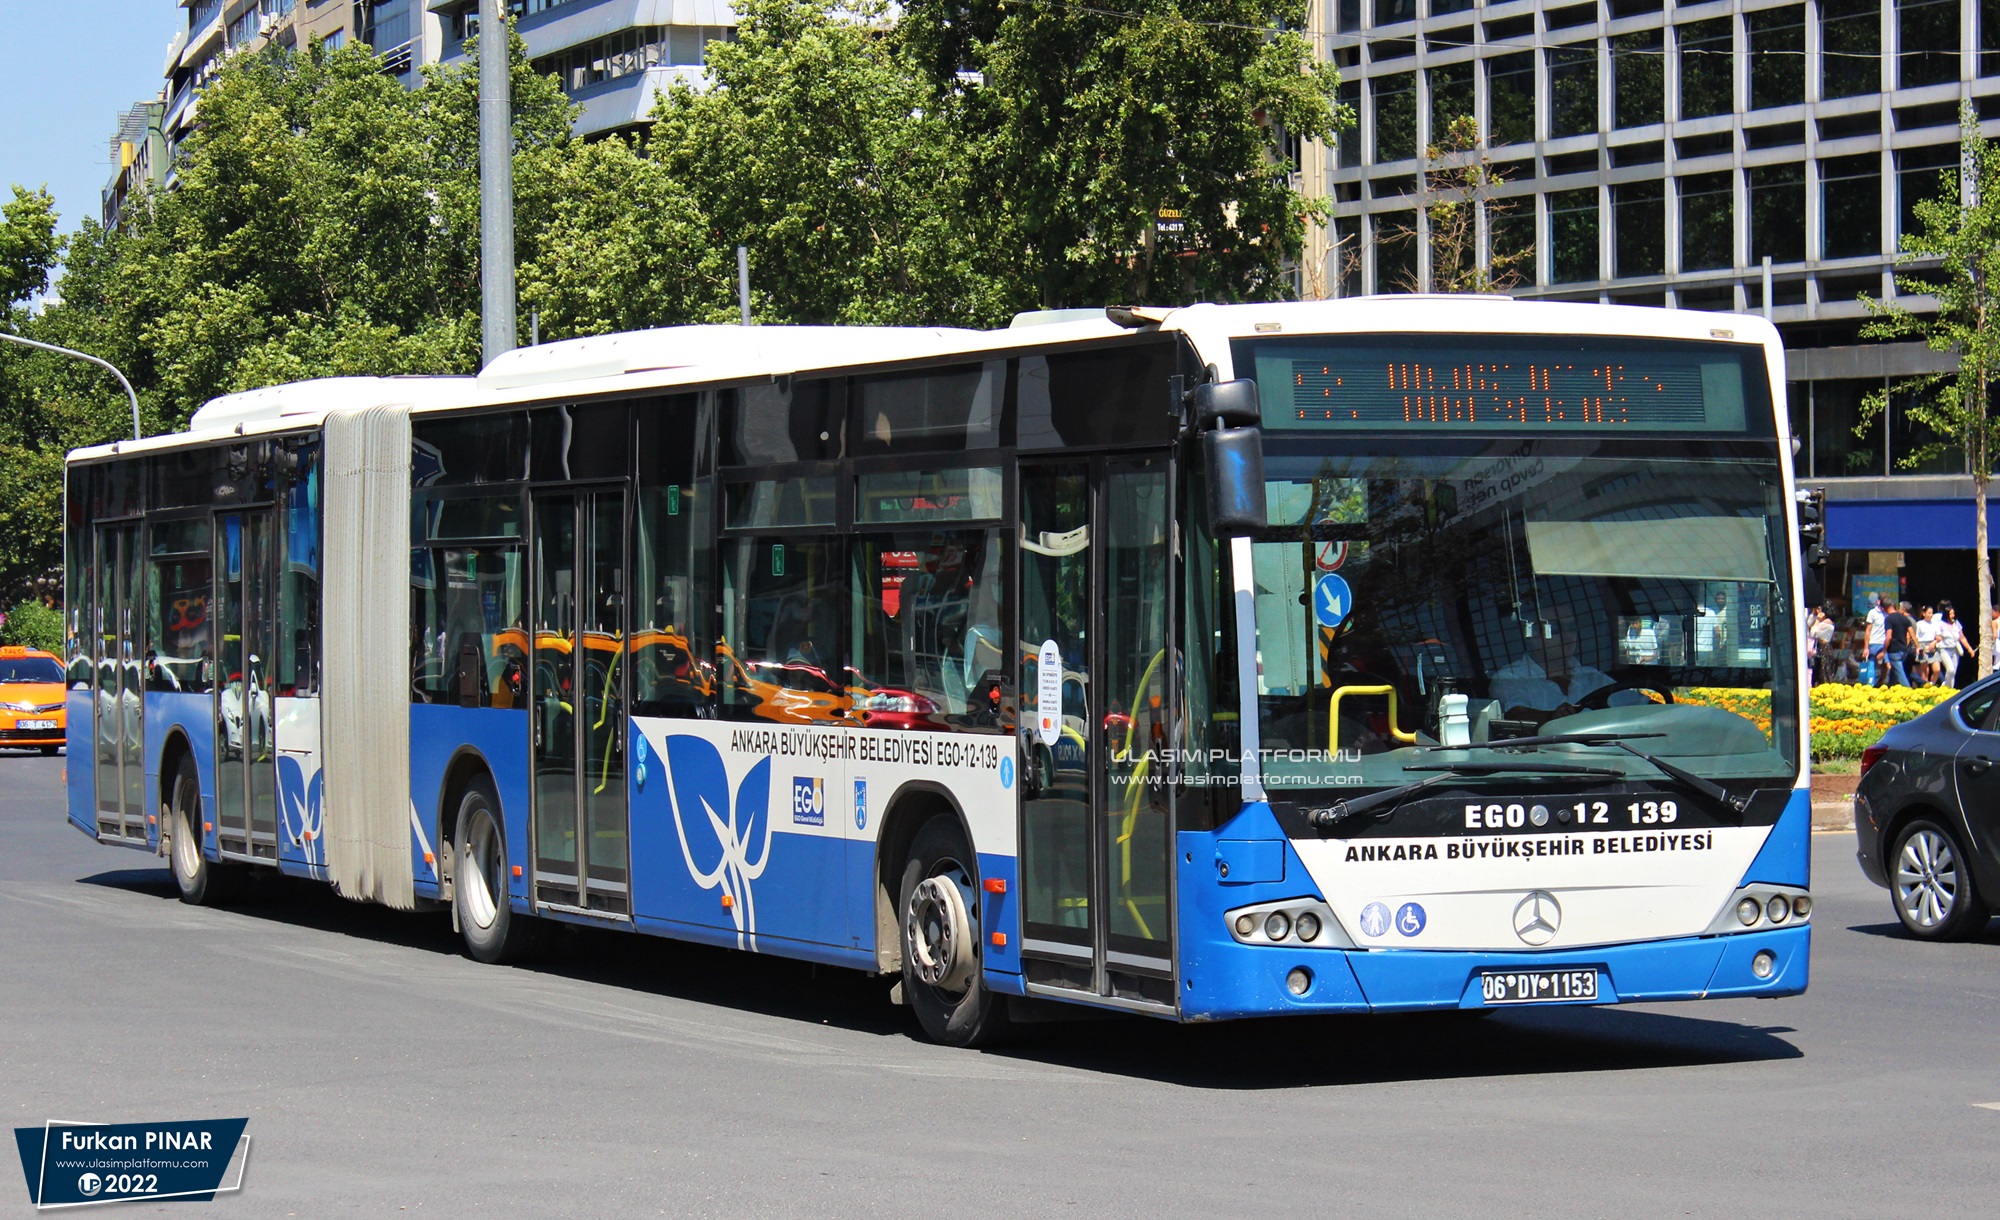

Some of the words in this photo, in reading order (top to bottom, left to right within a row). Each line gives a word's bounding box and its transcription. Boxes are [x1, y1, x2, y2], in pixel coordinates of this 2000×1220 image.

[731, 729, 778, 754] ANKARA
[781, 728, 857, 764] BÜYÜKŞEHİR
[860, 734, 933, 765] BELEDİYESİ
[937, 741, 998, 769] EGO-12-139
[794, 785, 823, 814] EGO
[1465, 804, 1526, 829] EGO
[1573, 802, 1609, 824] 12
[1627, 801, 1678, 824] 139
[1345, 843, 1439, 862] ANKARA
[1447, 835, 1585, 863] BÜYÜKŞEHİR
[1593, 830, 1713, 855] BELEDİYESİ
[1483, 975, 1506, 1000] 06
[1518, 974, 1540, 998] DY
[1551, 972, 1594, 996] 1153
